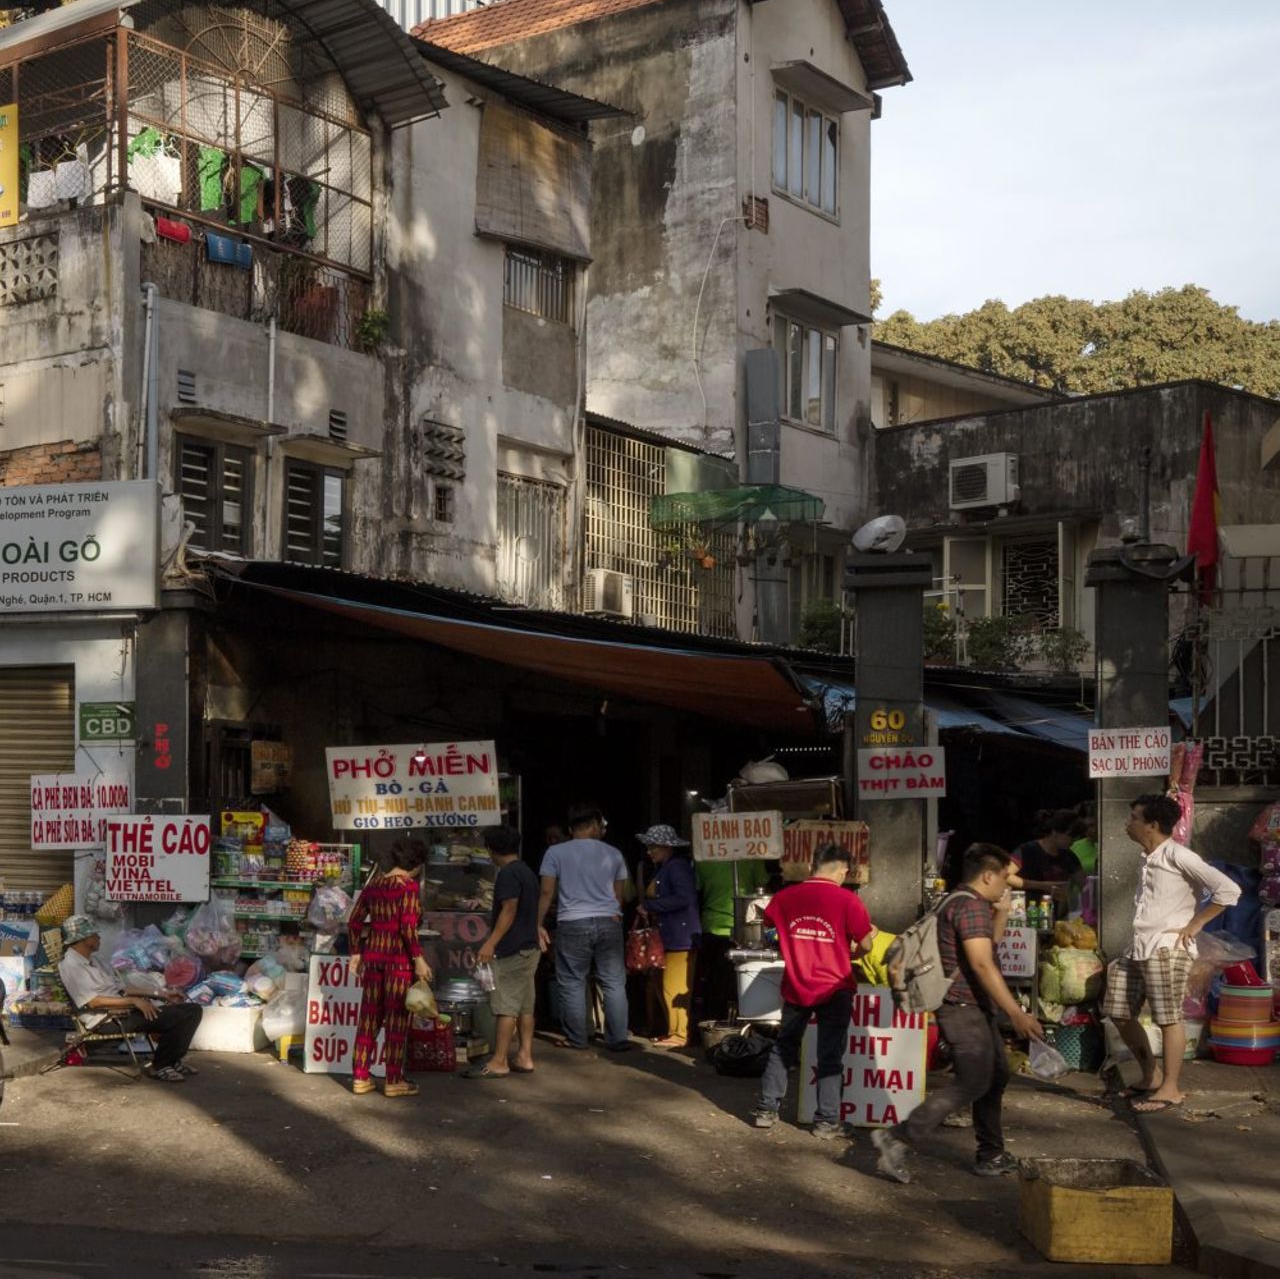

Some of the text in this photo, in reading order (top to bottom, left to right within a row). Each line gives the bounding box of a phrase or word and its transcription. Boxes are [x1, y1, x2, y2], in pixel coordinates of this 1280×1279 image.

[28, 492, 44, 504] VÀ
[46, 491, 74, 504] PHÁT
[48, 507, 91, 520] Program
[58, 533, 102, 563] GỖ
[2, 570, 75, 584] PRODUCTS
[87, 591, 112, 602] HCM
[86, 718, 131, 735] CBD
[870, 707, 906, 731] 60
[1091, 732, 1115, 750] BÁN
[333, 744, 490, 780] PHỞ MIẾN
[869, 751, 933, 770] CHÁO
[1092, 757, 1112, 774] SẠC
[1133, 753, 1168, 770] PHÒNG
[375, 779, 402, 795] BÒ
[419, 778, 449, 794] GÀ
[860, 778, 900, 793] THỊT
[32, 780, 42, 810] CÀ
[45, 780, 61, 810] PHÊ
[458, 795, 497, 812] CANH
[46, 814, 62, 843] PHÊ
[64, 813, 79, 843] SỮA
[384, 816, 413, 828] HEO
[425, 813, 477, 827] XƯƠNG
[703, 816, 772, 840] BÁNH BAO
[108, 816, 155, 854] THẺ
[707, 842, 728, 858] 15
[746, 841, 768, 856] 20
[113, 855, 154, 867] MOBI
[112, 868, 151, 880] VINA
[106, 880, 175, 892] VIETTEL
[110, 893, 182, 901] VIETNAMOBILE
[318, 957, 350, 987] XÔI
[308, 995, 359, 1026] BÁNH
[313, 1032, 348, 1062] SÚP
[849, 1036, 892, 1060] HỊT
[863, 1068, 913, 1094] MẠI
[866, 1104, 898, 1125] LA
